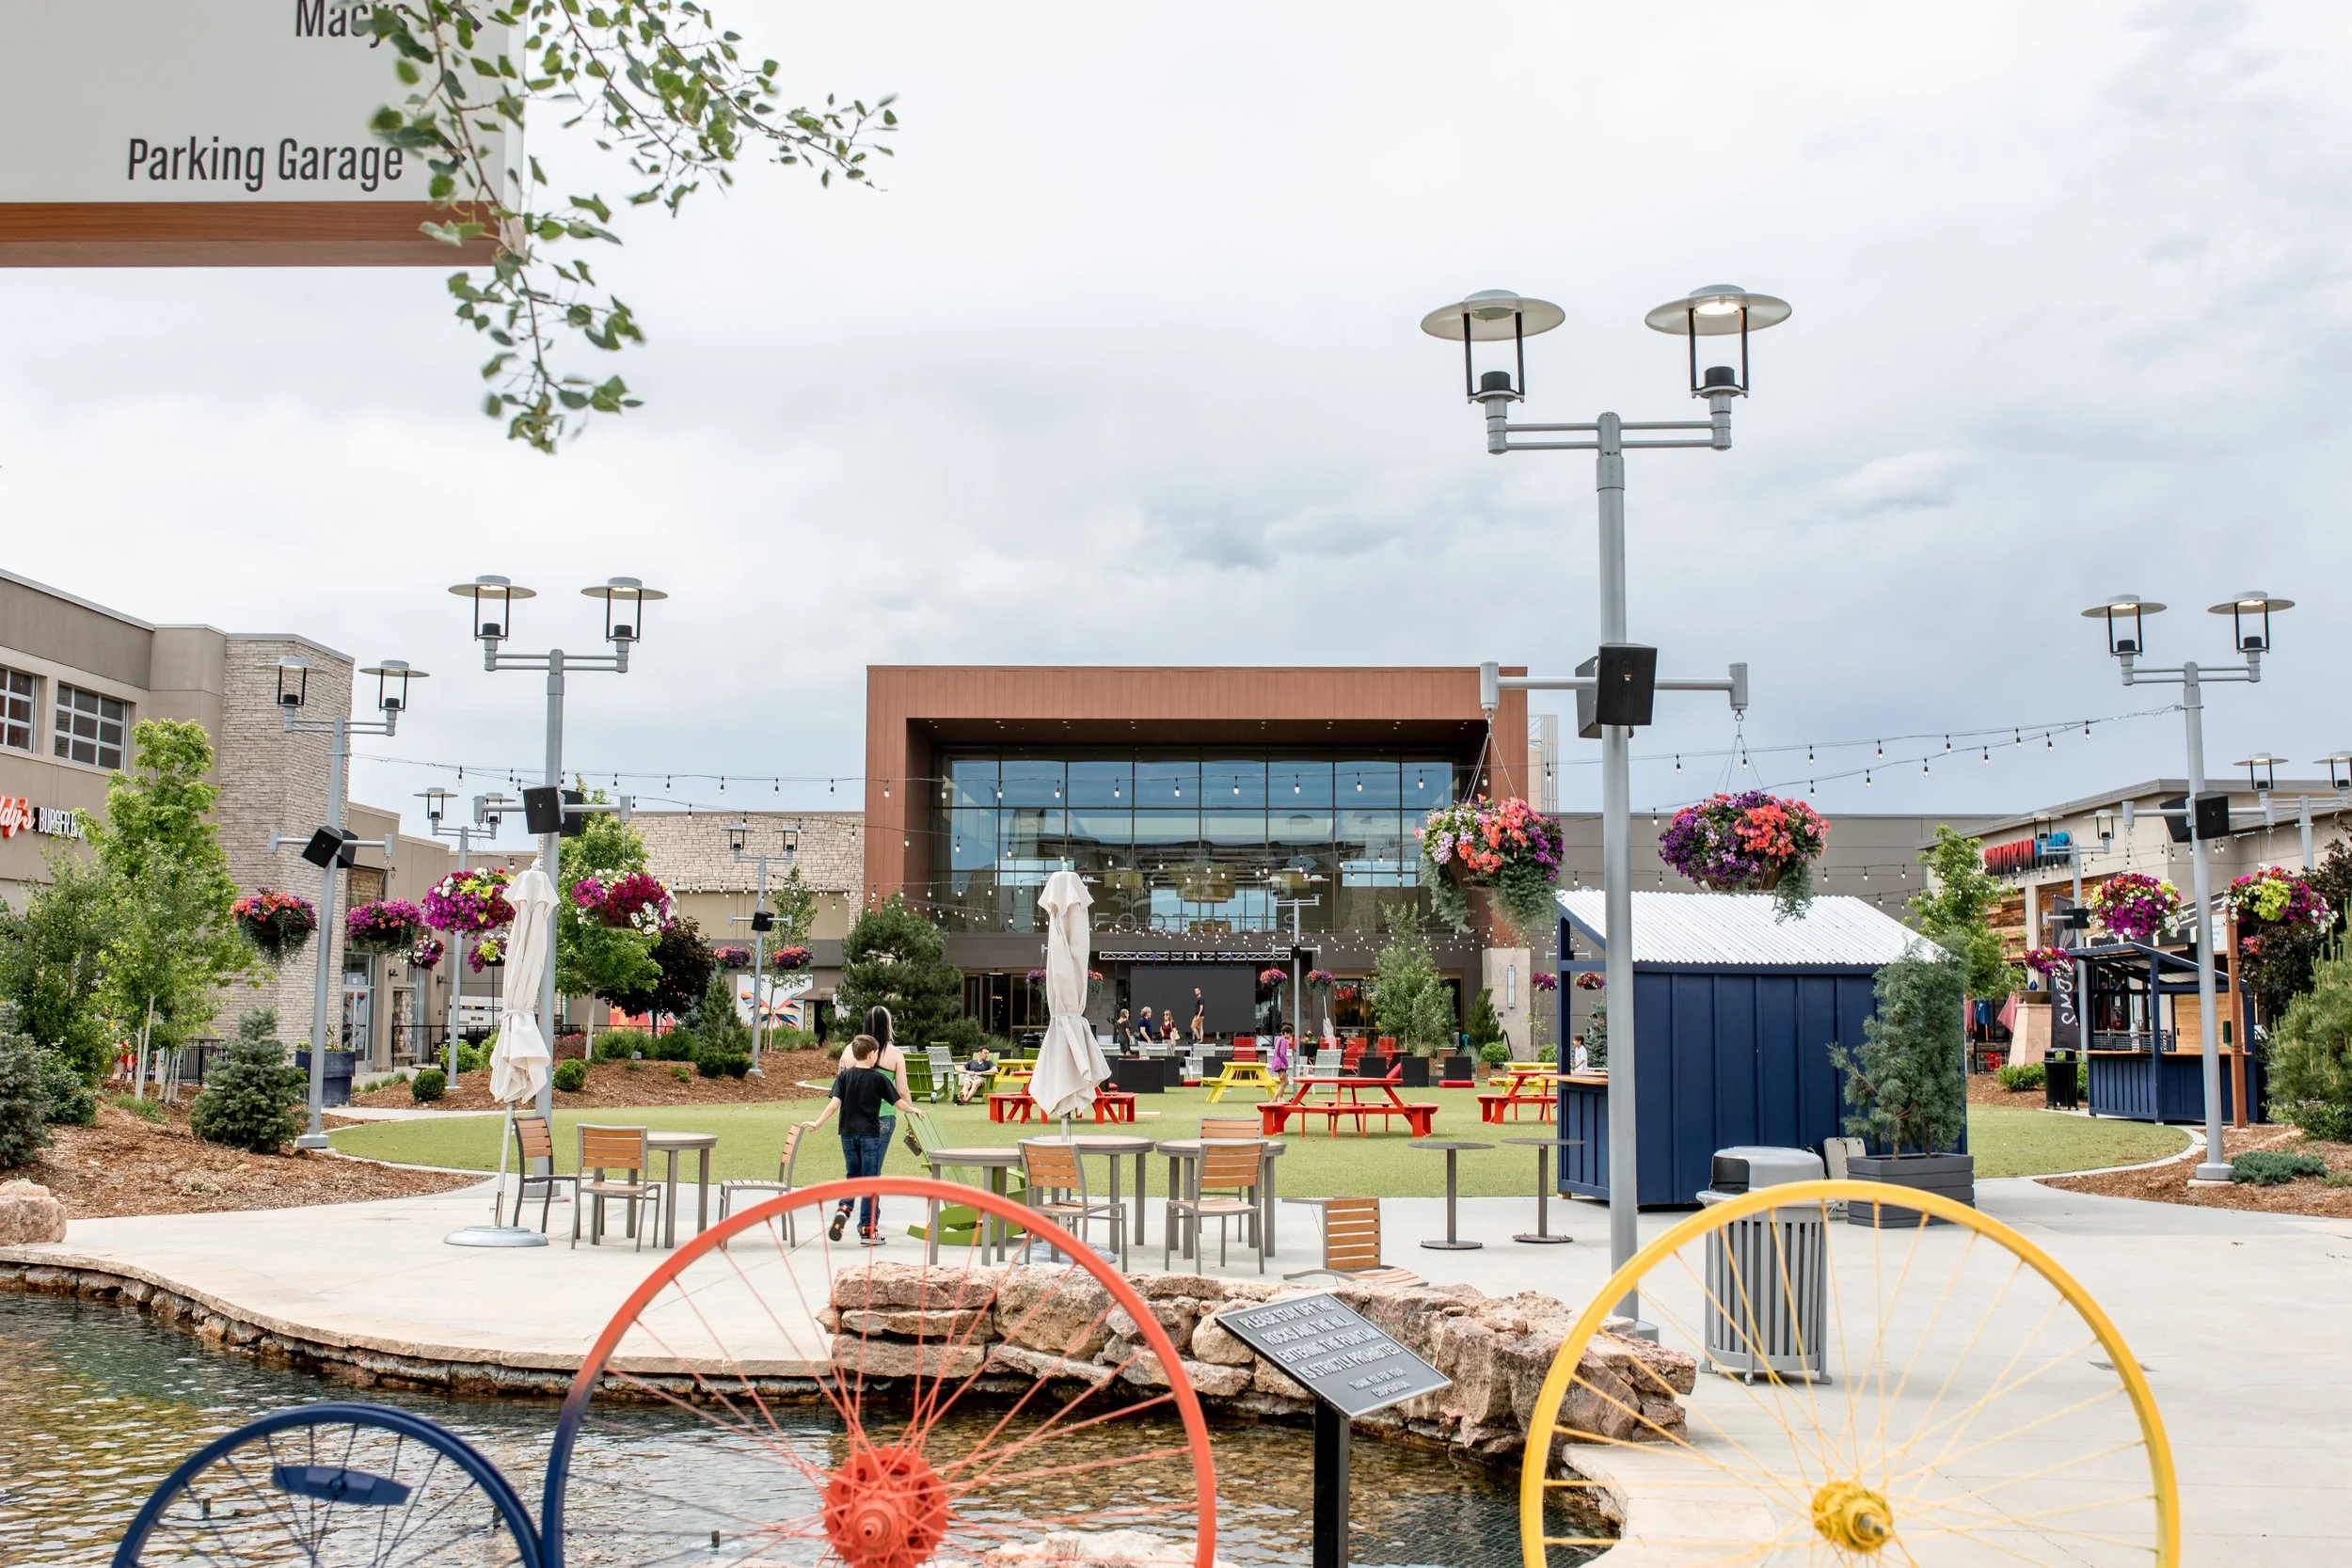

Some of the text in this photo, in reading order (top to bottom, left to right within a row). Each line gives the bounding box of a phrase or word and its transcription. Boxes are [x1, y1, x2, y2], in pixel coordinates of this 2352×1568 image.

[128, 136, 403, 192] Parking Garage
[1984, 839, 2034, 876] SMOKIN
[1237, 1299, 1336, 1330] PLEASE STAY OFF THE
[1260, 1327, 1299, 1346] ROCKS
[1292, 1323, 1318, 1338] AND
[1309, 1319, 1336, 1334] THE
[1276, 1327, 1383, 1364] ENTERING THE FOUNTAIN
[1296, 1366, 1317, 1380] IS
[1309, 1355, 1357, 1377] STRICTLY
